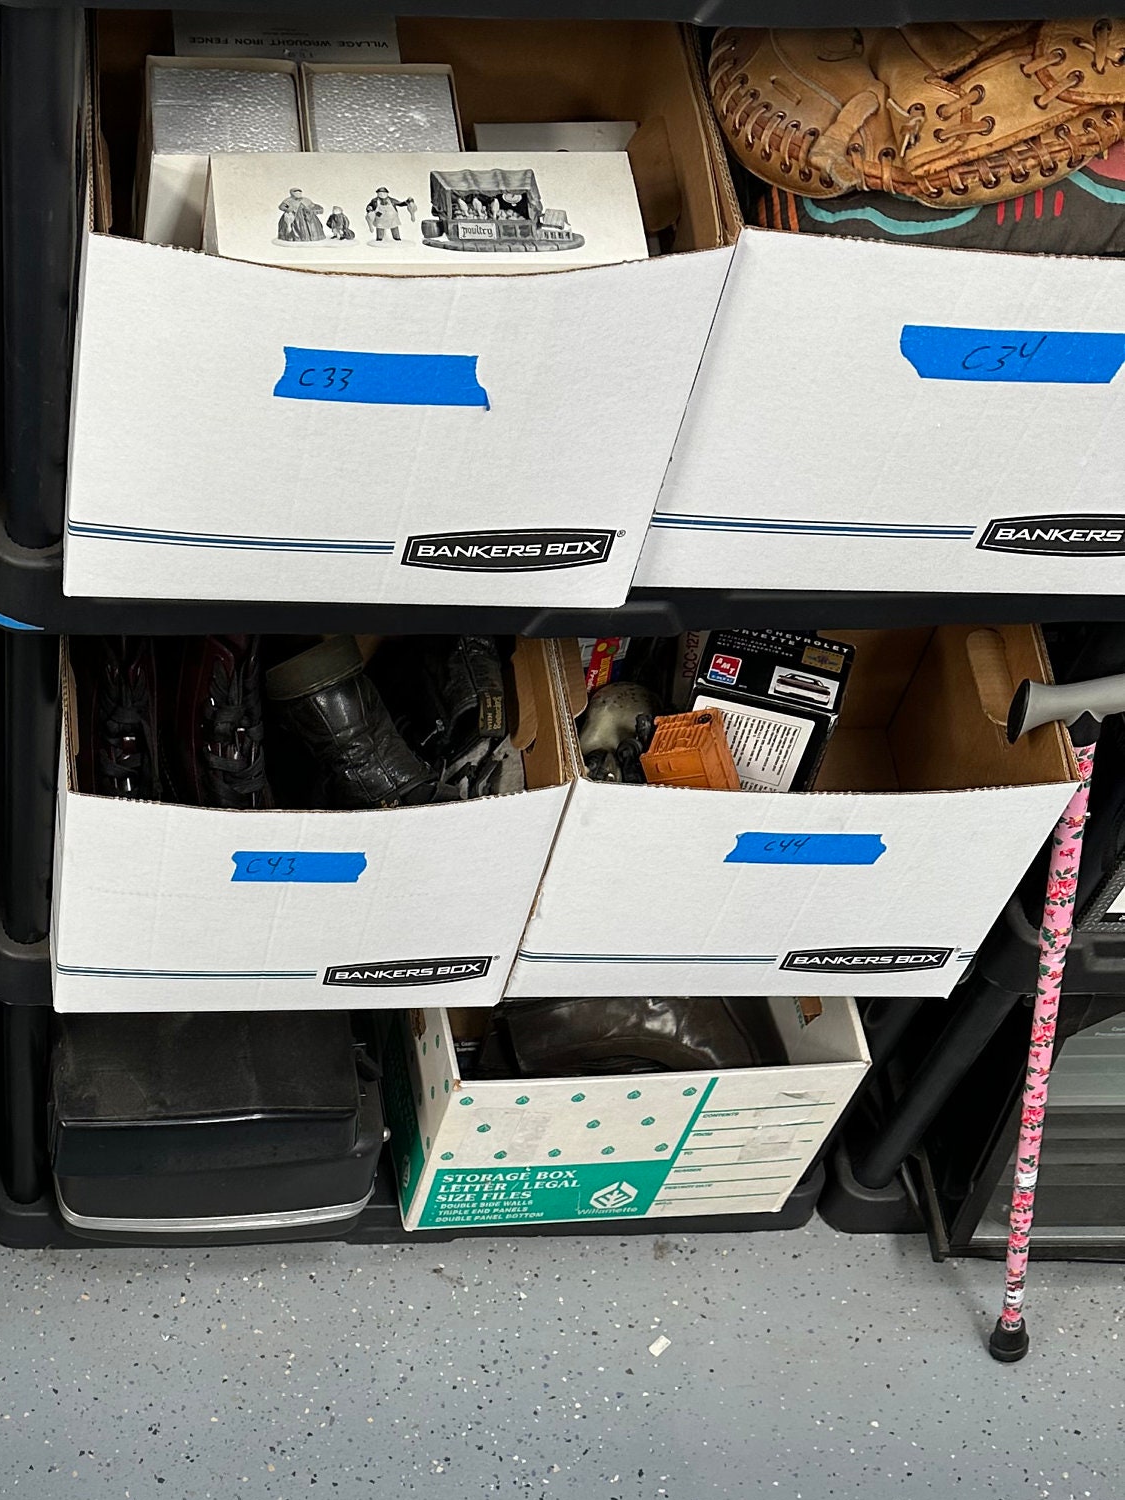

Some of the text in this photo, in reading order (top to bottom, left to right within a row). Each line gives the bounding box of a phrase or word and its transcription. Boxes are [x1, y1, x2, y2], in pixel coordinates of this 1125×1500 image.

[188, 36, 389, 49] VILLAGE WROUGHT IRON FENCE
[461, 224, 493, 238] poultry
[961, 335, 1048, 372] C34
[298, 367, 355, 391] C33
[994, 528, 1125, 543] BANKERS
[416, 538, 603, 560] BANKERS BOX
[766, 629, 849, 654] CHEVROLET
[715, 657, 736, 674] AMT
[763, 836, 811, 854] C44
[245, 856, 297, 876] C43
[792, 951, 942, 968] BANKERS BOX
[334, 962, 482, 982] BANKERS BOX
[442, 1169, 578, 1183] STORAGE BOX
[438, 1182, 507, 1193] LETTER
[522, 1179, 581, 1190] LEGAL
[435, 1191, 532, 1203] SIZE FILES
[435, 1212, 544, 1223] DOUBLE PANEL BOTTOM
[438, 1208, 470, 1216] TRIPLE
[492, 1206, 529, 1214] PANELS
[577, 1205, 638, 1216] Willamette
